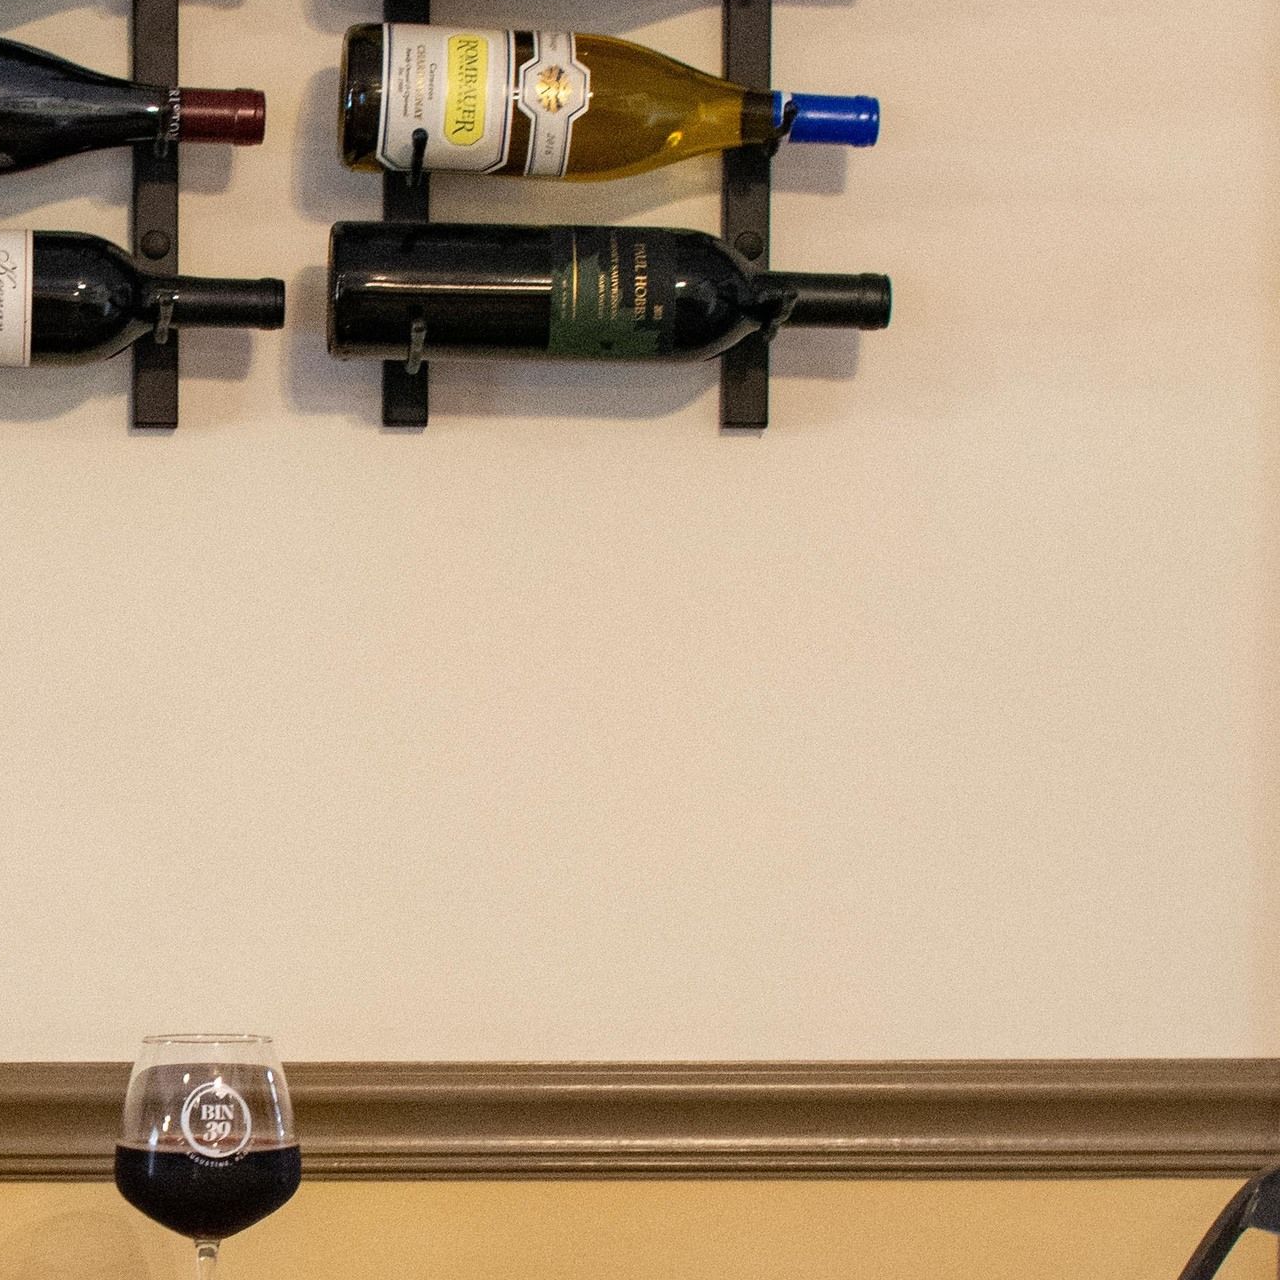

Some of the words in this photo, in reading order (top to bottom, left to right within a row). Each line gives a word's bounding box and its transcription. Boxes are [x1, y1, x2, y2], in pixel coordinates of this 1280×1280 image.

[451, 39, 480, 136] ROMBAUER
[633, 243, 647, 271] PAUL
[632, 274, 648, 322] HOBBS
[200, 1103, 235, 1121] BIN
[203, 1121, 232, 1142] 39
